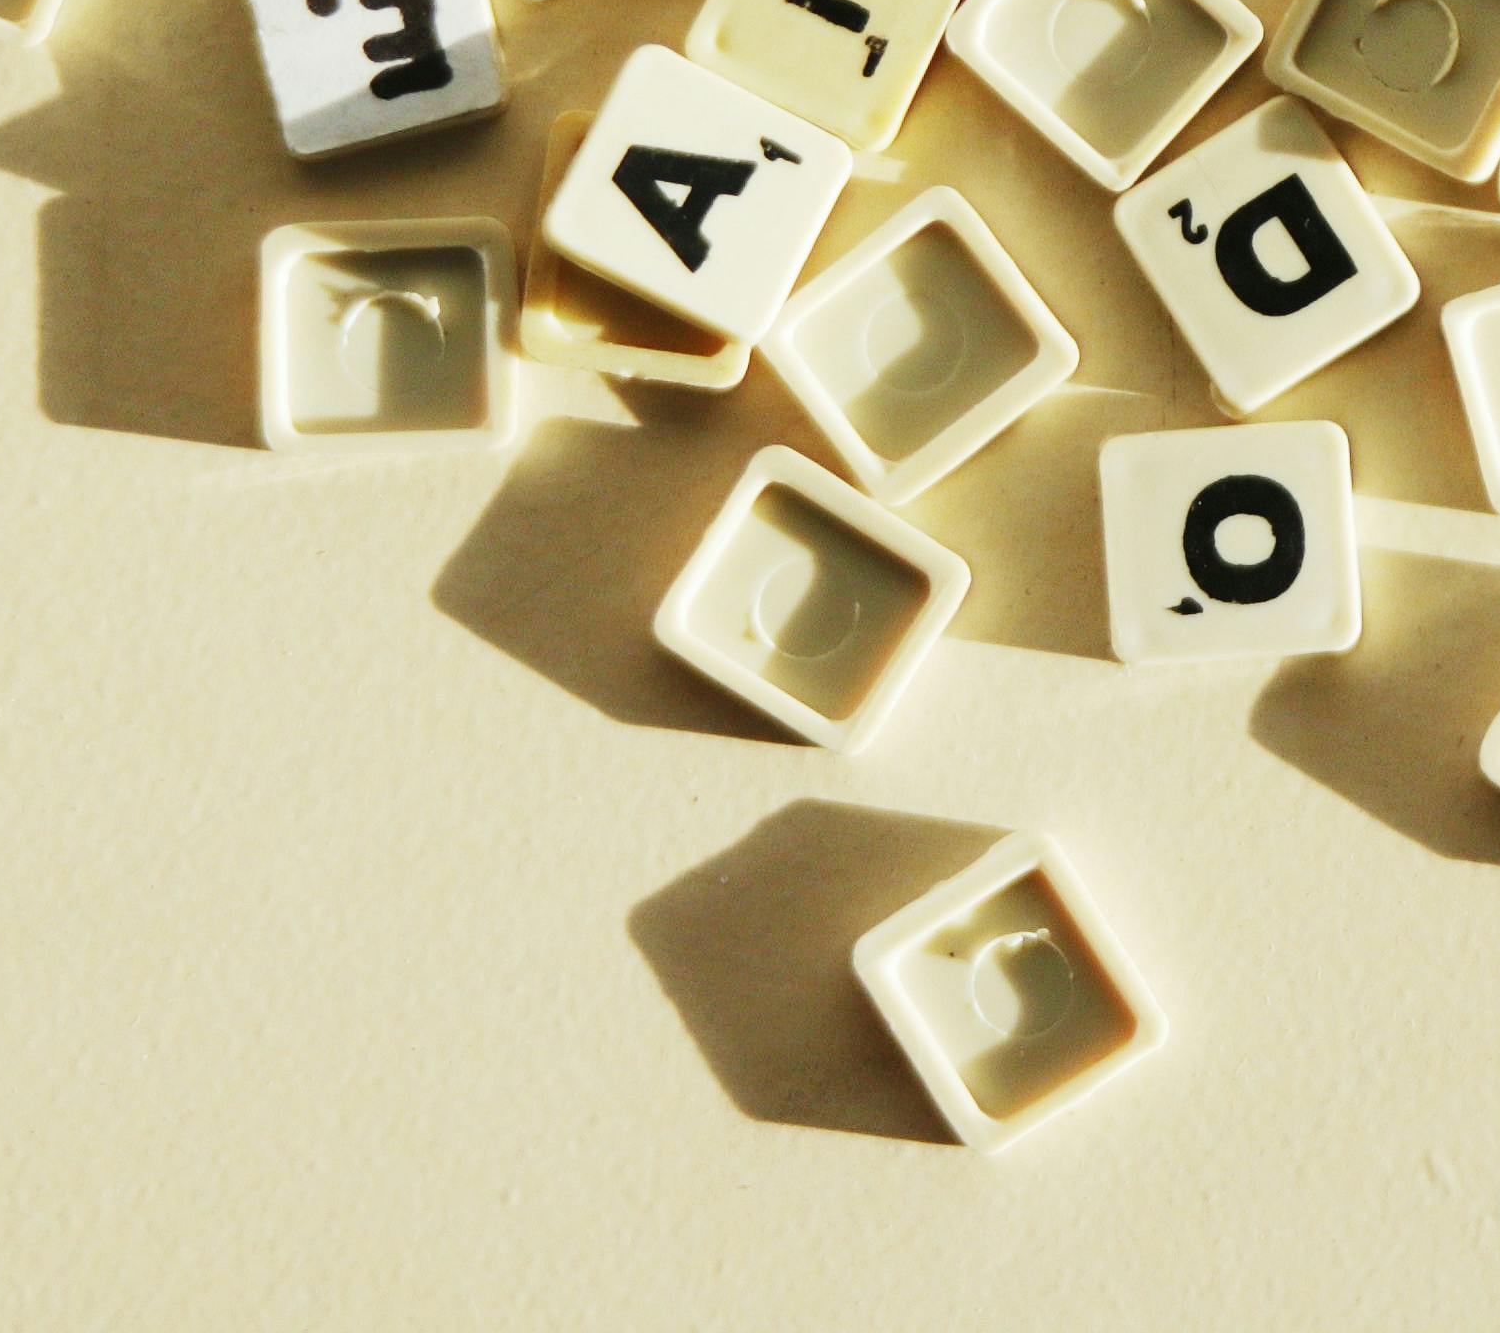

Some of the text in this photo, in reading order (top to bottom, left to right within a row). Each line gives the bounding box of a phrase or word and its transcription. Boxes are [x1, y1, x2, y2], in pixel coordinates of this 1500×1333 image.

[612, 139, 800, 273] A 1
[1168, 173, 1357, 316] D 2
[1183, 475, 1305, 604] O
